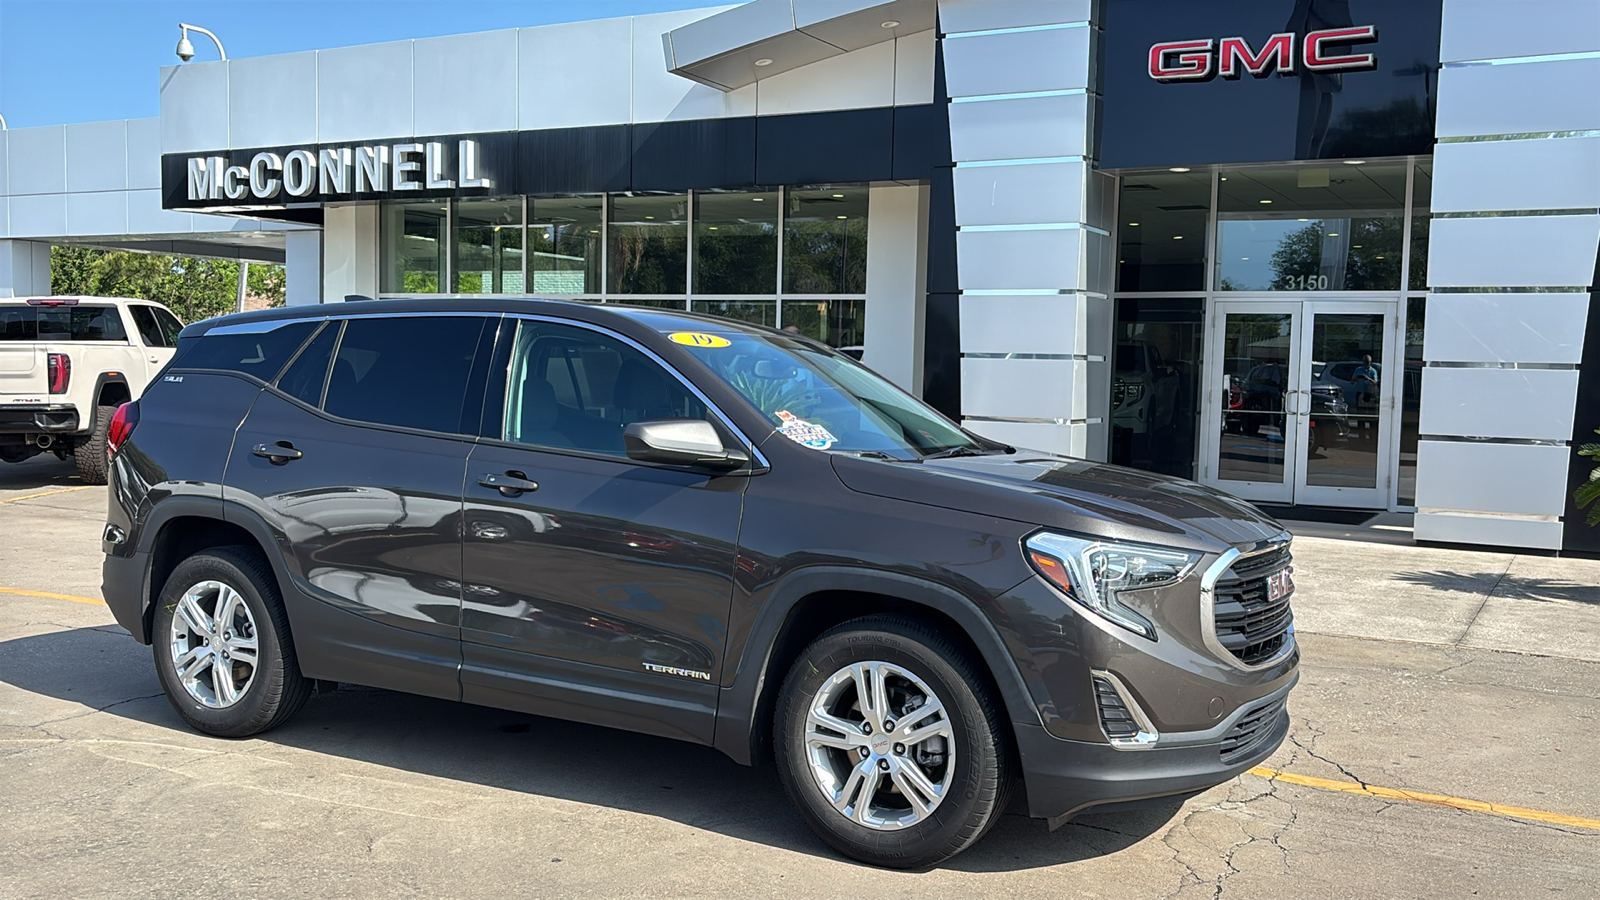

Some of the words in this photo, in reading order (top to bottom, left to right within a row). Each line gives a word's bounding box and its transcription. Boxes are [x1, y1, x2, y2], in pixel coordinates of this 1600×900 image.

[1148, 25, 1376, 81] GMC
[187, 139, 491, 200] McCONNELL
[1285, 274, 1328, 290] 3150
[690, 334, 713, 345] 19
[847, 634, 883, 643] TOURING
[642, 662, 711, 680] TERRAIN
